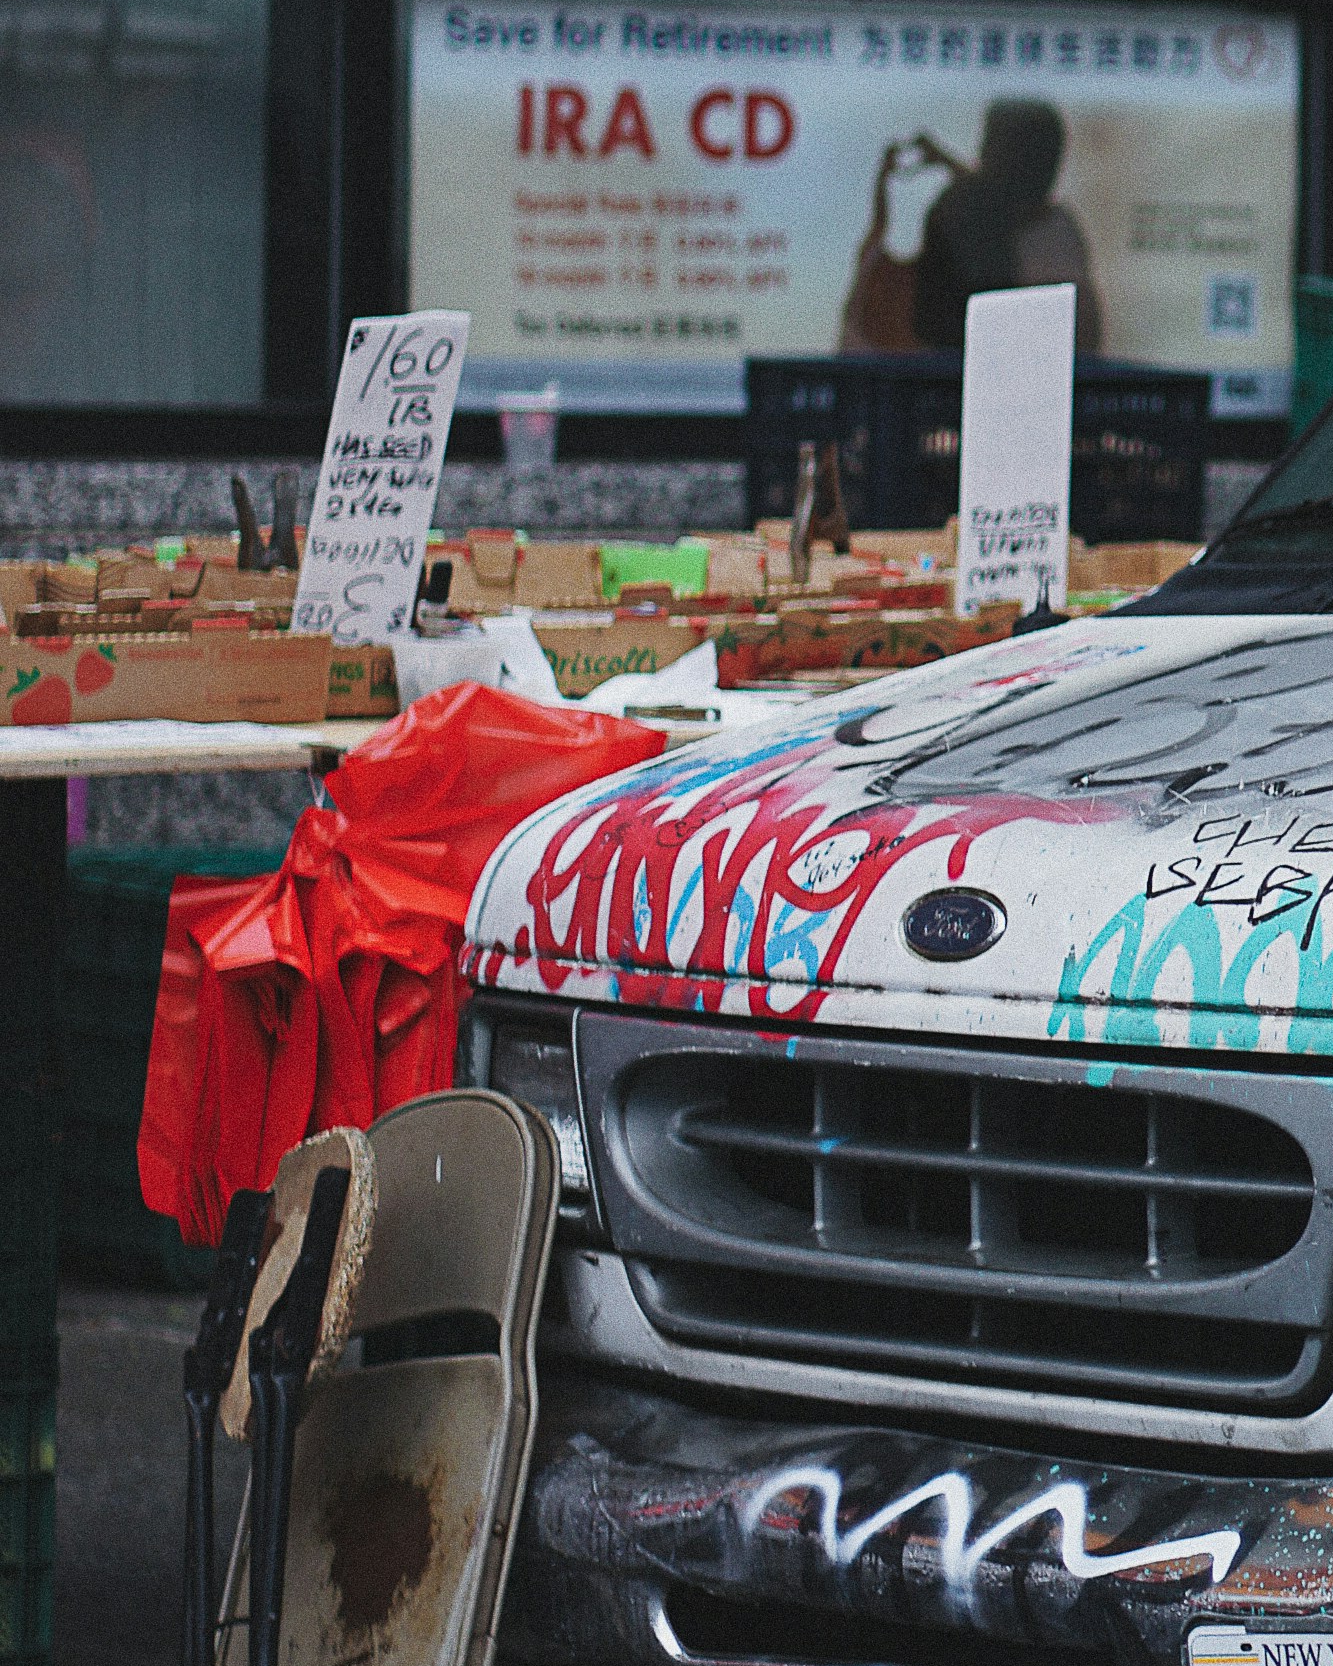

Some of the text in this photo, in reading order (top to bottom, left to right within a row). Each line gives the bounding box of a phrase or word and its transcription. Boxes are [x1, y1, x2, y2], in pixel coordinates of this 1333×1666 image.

[447, 7, 833, 60] Save for Retirement
[517, 83, 796, 163] IRA CD
